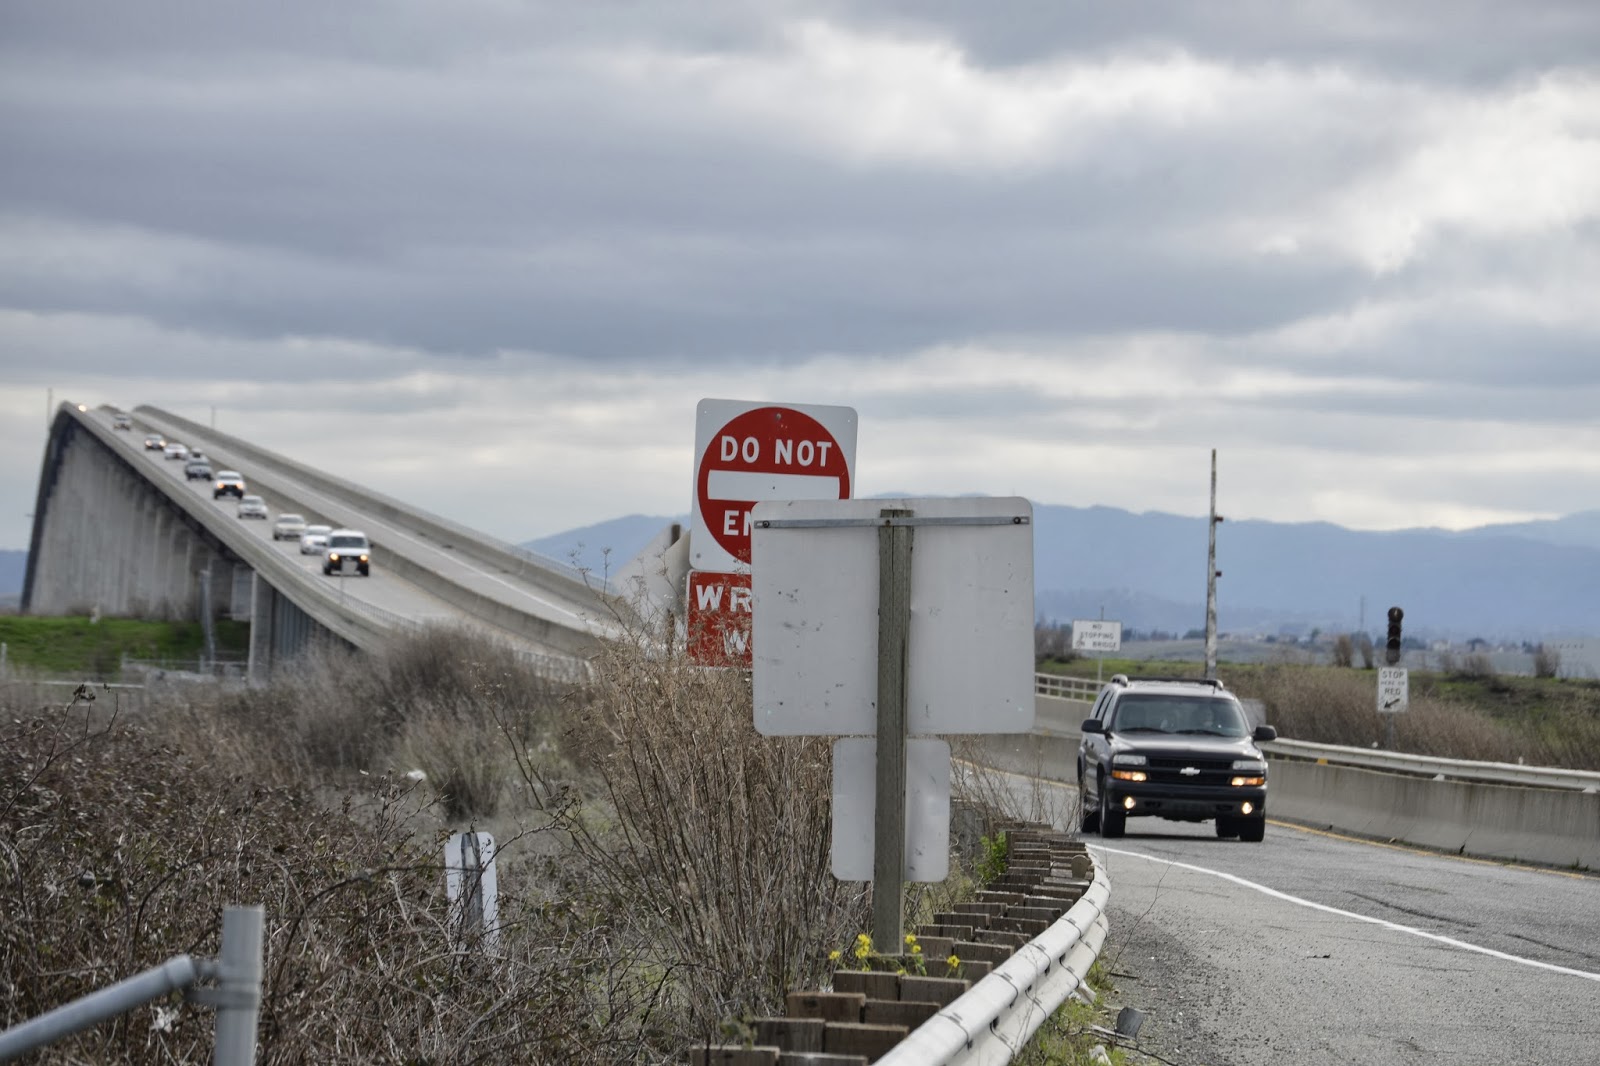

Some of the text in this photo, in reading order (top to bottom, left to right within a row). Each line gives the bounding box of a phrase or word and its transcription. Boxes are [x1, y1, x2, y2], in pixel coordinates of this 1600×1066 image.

[720, 435, 833, 468] DO NOT
[1080, 631, 1115, 640] STOPPING
[1381, 670, 1405, 679] STOP
[1384, 687, 1402, 696] RED
